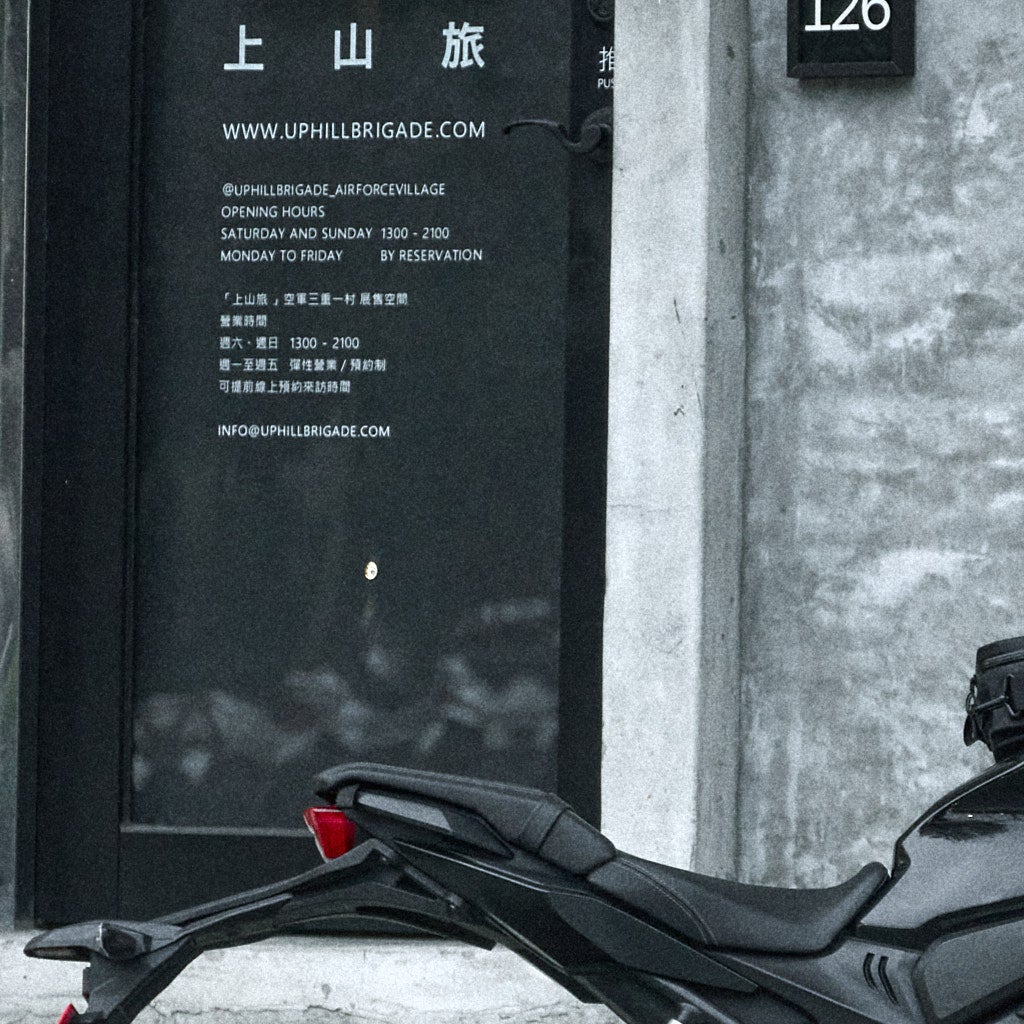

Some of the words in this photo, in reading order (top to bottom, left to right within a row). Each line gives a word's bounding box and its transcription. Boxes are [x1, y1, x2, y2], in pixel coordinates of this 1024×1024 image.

[804, 0, 892, 32] 126
[222, 120, 486, 141] WWW.UPHILLBRIGADE.COM
[222, 182, 446, 198] @UPHILLBRIGADE_AIRFORCEVILLAGE
[221, 205, 278, 219] OPENING
[282, 205, 326, 218] HOURS
[220, 227, 285, 241] SATURDAY
[289, 227, 318, 240] AND
[321, 226, 373, 240] SUNDAY
[381, 226, 409, 240] 1300
[422, 226, 450, 240] 2100
[220, 249, 276, 263] MONDAY
[280, 249, 297, 262] TO
[300, 248, 343, 262] FRIDAY
[380, 249, 395, 262] BY
[399, 248, 483, 262] RESERVATION
[290, 336, 318, 350] 1300
[332, 336, 360, 350] 2100
[217, 424, 391, 438] INFO@UPHILLBRIGADE.COM
